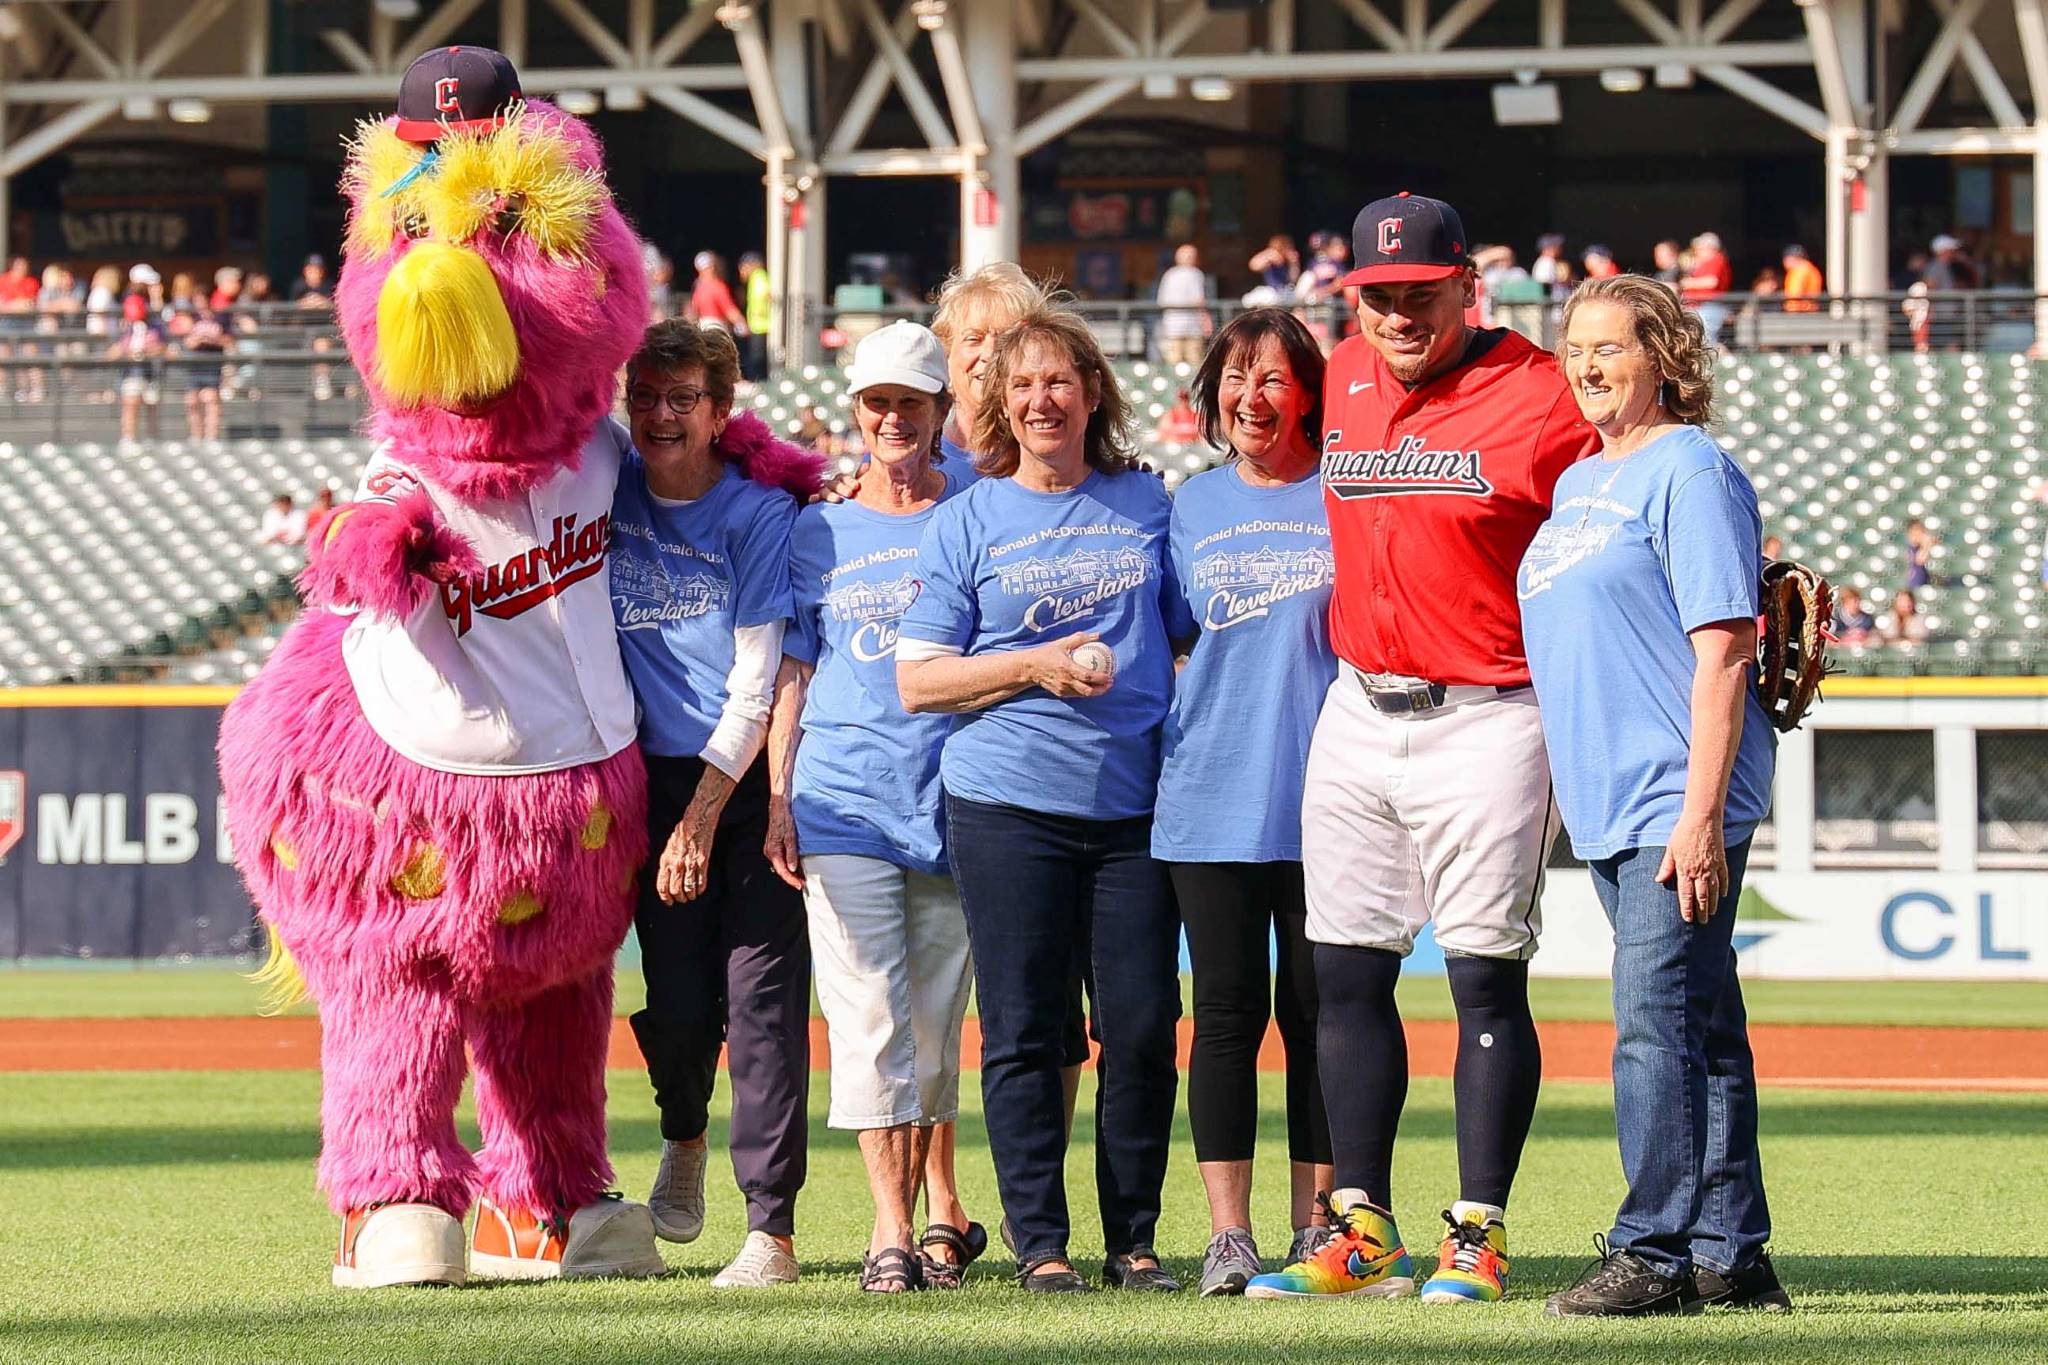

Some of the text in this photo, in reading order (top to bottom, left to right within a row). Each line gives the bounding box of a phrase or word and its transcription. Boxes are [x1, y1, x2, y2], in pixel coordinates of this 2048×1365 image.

[434, 77, 459, 112] C
[1377, 217, 1403, 255] C
[1320, 430, 1494, 501] Guardians
[989, 534, 1038, 558] Ronald
[1040, 524, 1109, 541] McDonald
[1194, 520, 1332, 553] Ronald McDonald Hou
[821, 547, 919, 586] Ronald McDon
[1024, 562, 1146, 633] Cleveland
[1205, 566, 1325, 631] Cleveland
[1411, 693, 1430, 711] 22
[37, 792, 200, 865] MLB
[1880, 891, 2031, 960] CL
